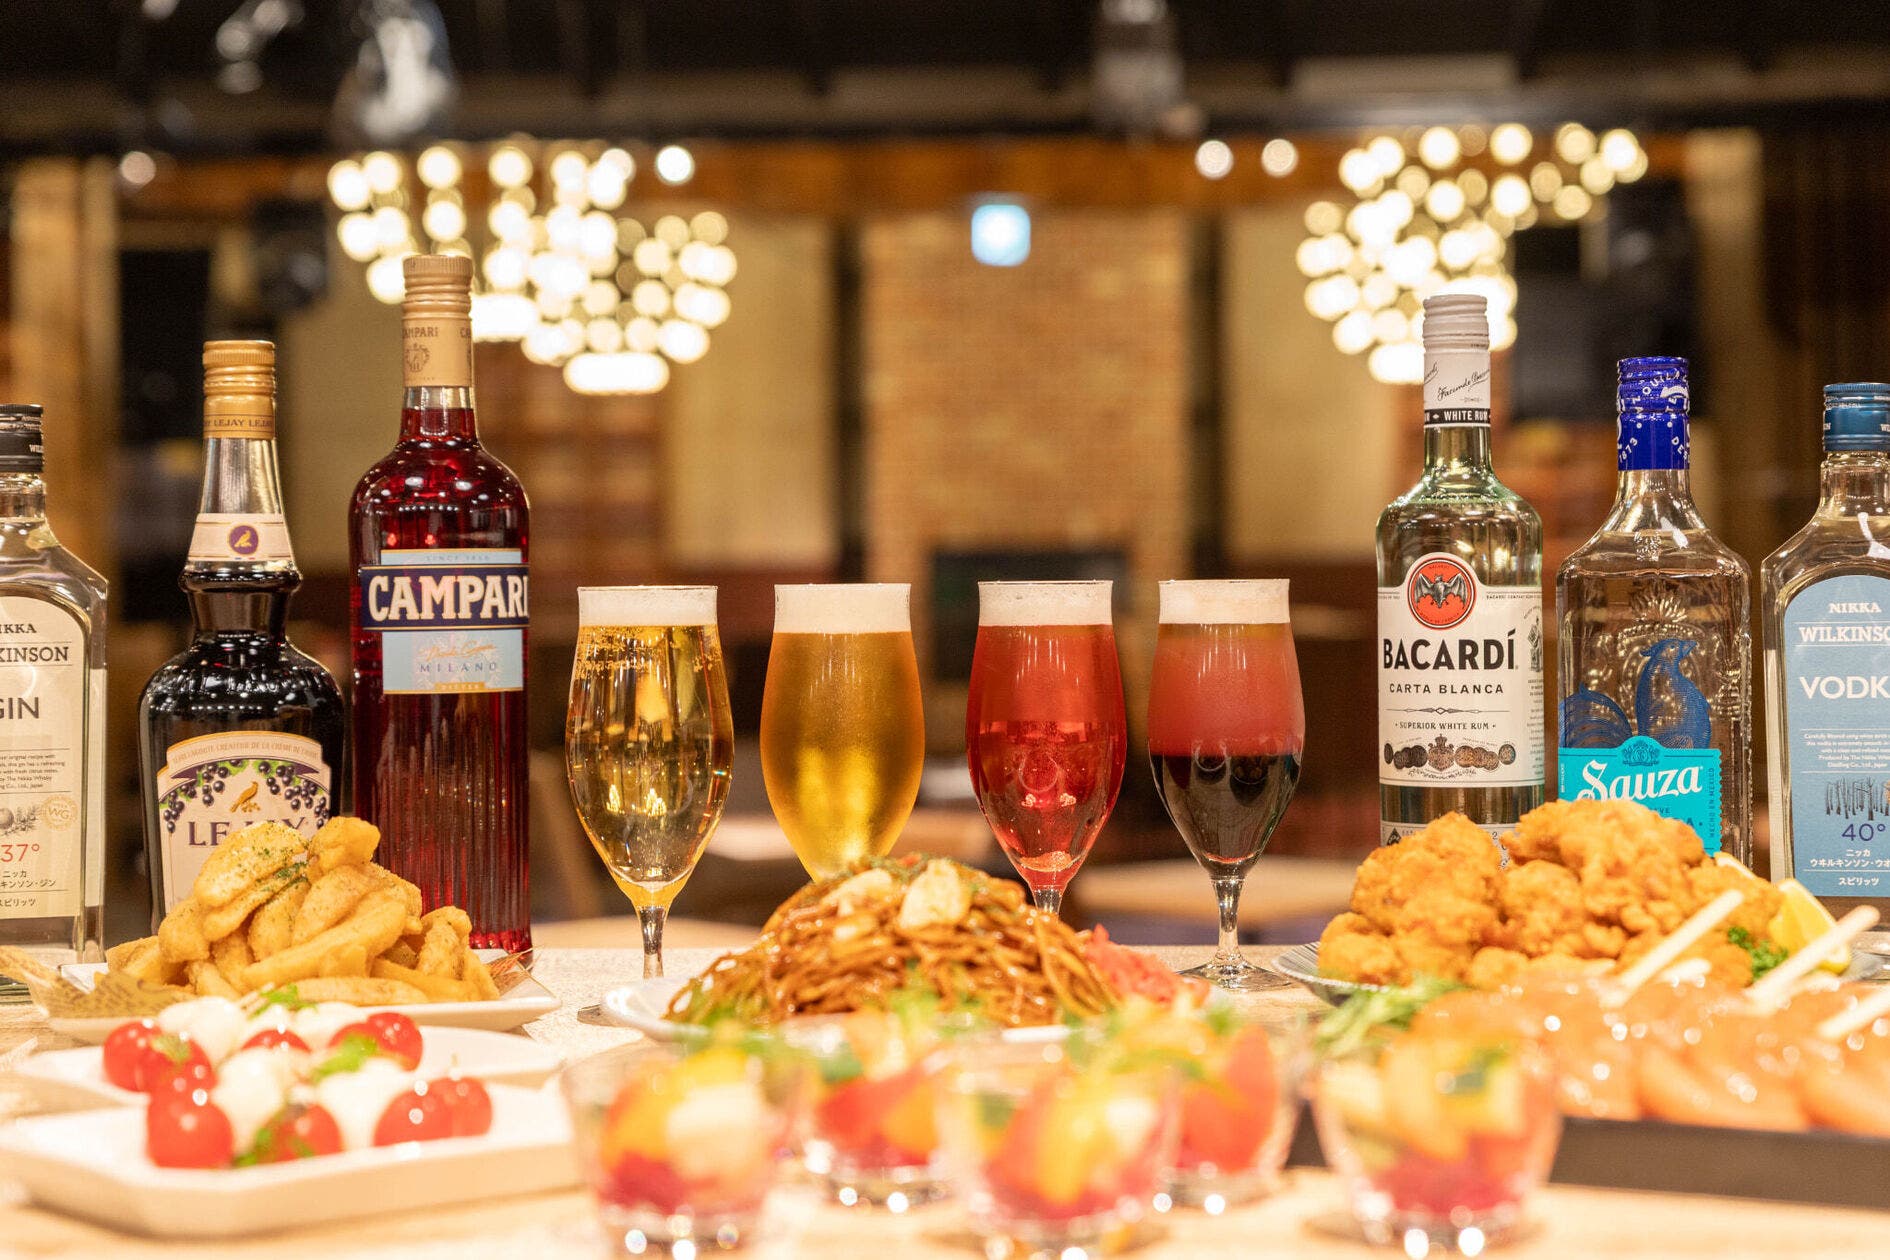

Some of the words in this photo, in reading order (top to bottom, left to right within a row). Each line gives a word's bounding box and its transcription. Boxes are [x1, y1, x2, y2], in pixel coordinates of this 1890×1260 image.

[403, 327, 438, 338] AMPARI
[1444, 410, 1473, 421] WHITE
[1474, 410, 1489, 421] RUM
[367, 574, 529, 622] CAMPARI
[1828, 603, 1882, 614] NIKKA
[1383, 628, 1516, 670] BACARDÍ
[420, 661, 497, 673] MILANO
[1389, 683, 1431, 695] CARTA
[1438, 683, 1504, 694] BLANCA
[1399, 722, 1437, 730] SUPERIOR
[1439, 722, 1467, 730] WHITE
[1470, 722, 1489, 730] RUM
[1576, 759, 1703, 803] Sauza
[1841, 823, 1886, 842] 40°
[0, 843, 40, 863] 37°
[1845, 848, 1872, 858] ニッカ
